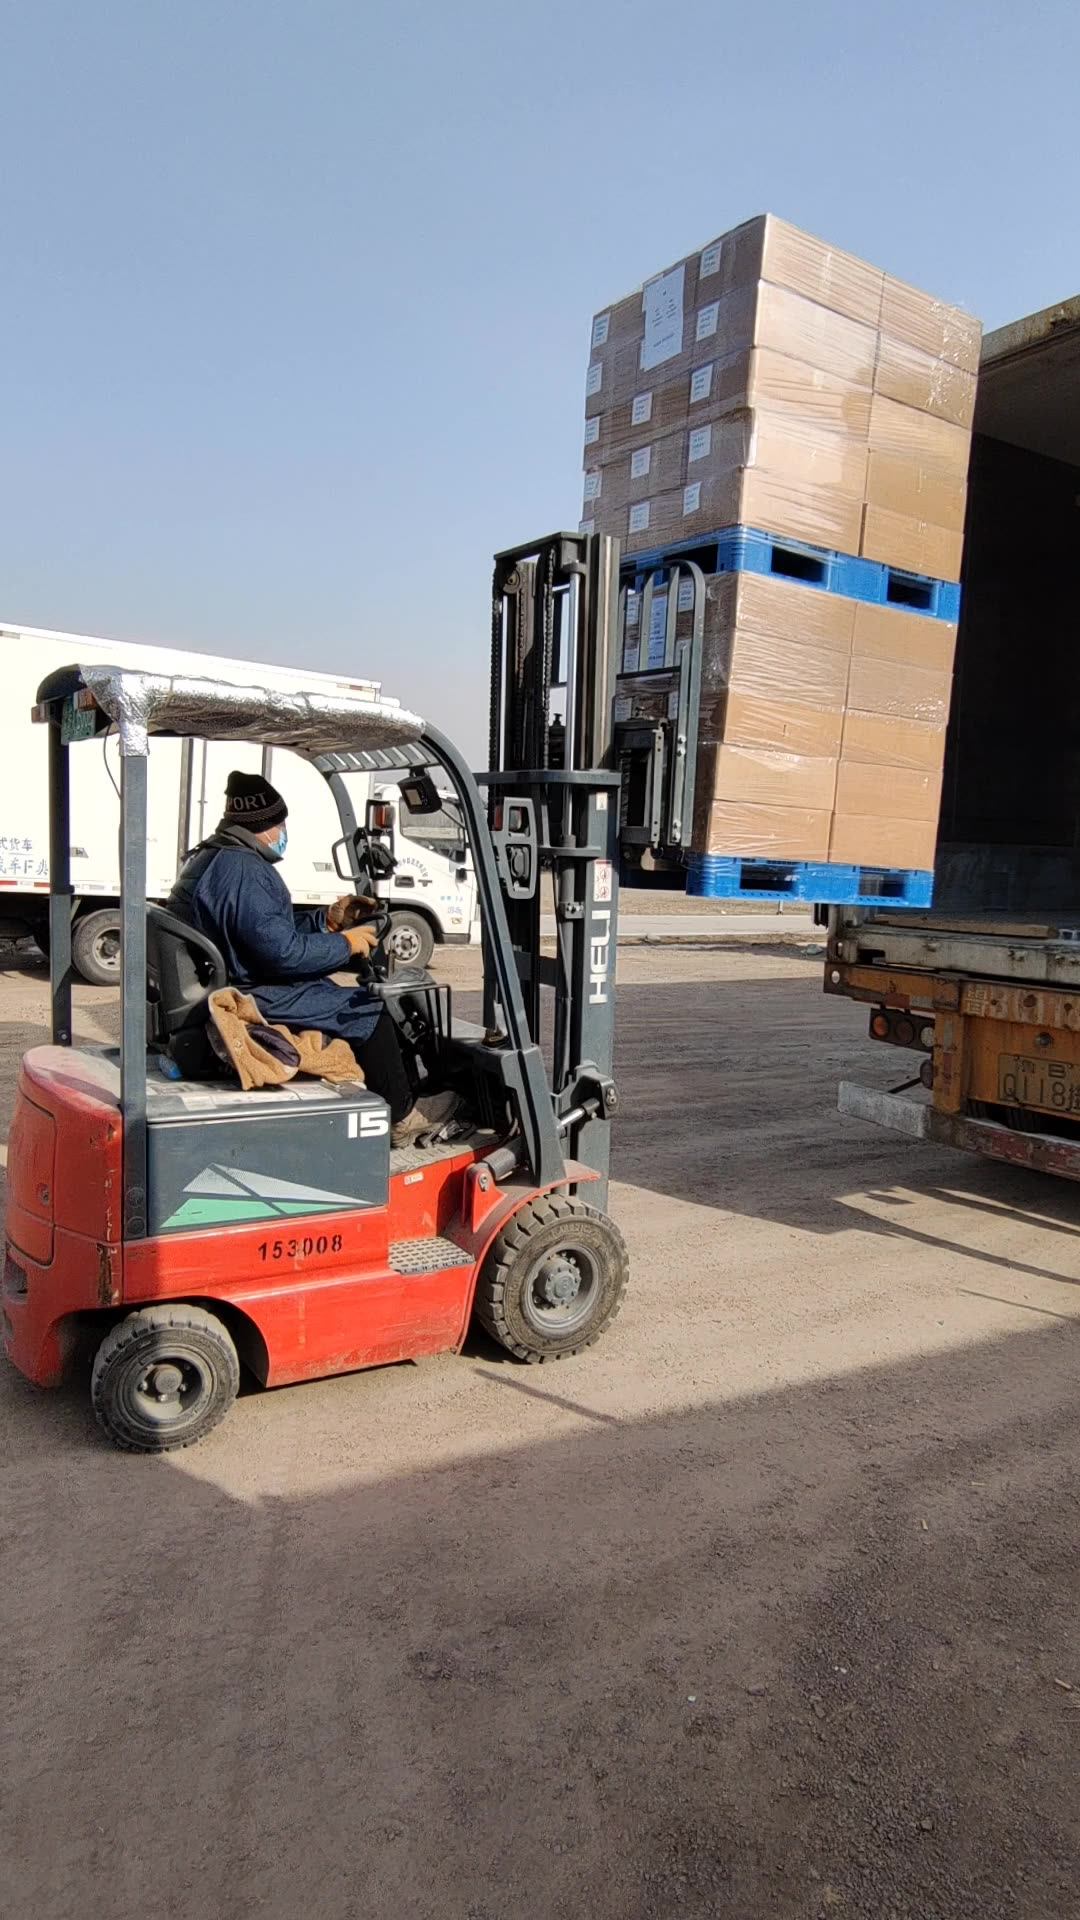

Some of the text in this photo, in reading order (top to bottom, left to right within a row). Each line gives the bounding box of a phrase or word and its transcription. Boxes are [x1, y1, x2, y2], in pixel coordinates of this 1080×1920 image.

[590, 910, 611, 1004] HELI
[348, 1110, 389, 1138] 15
[258, 1234, 343, 1261] 153008
